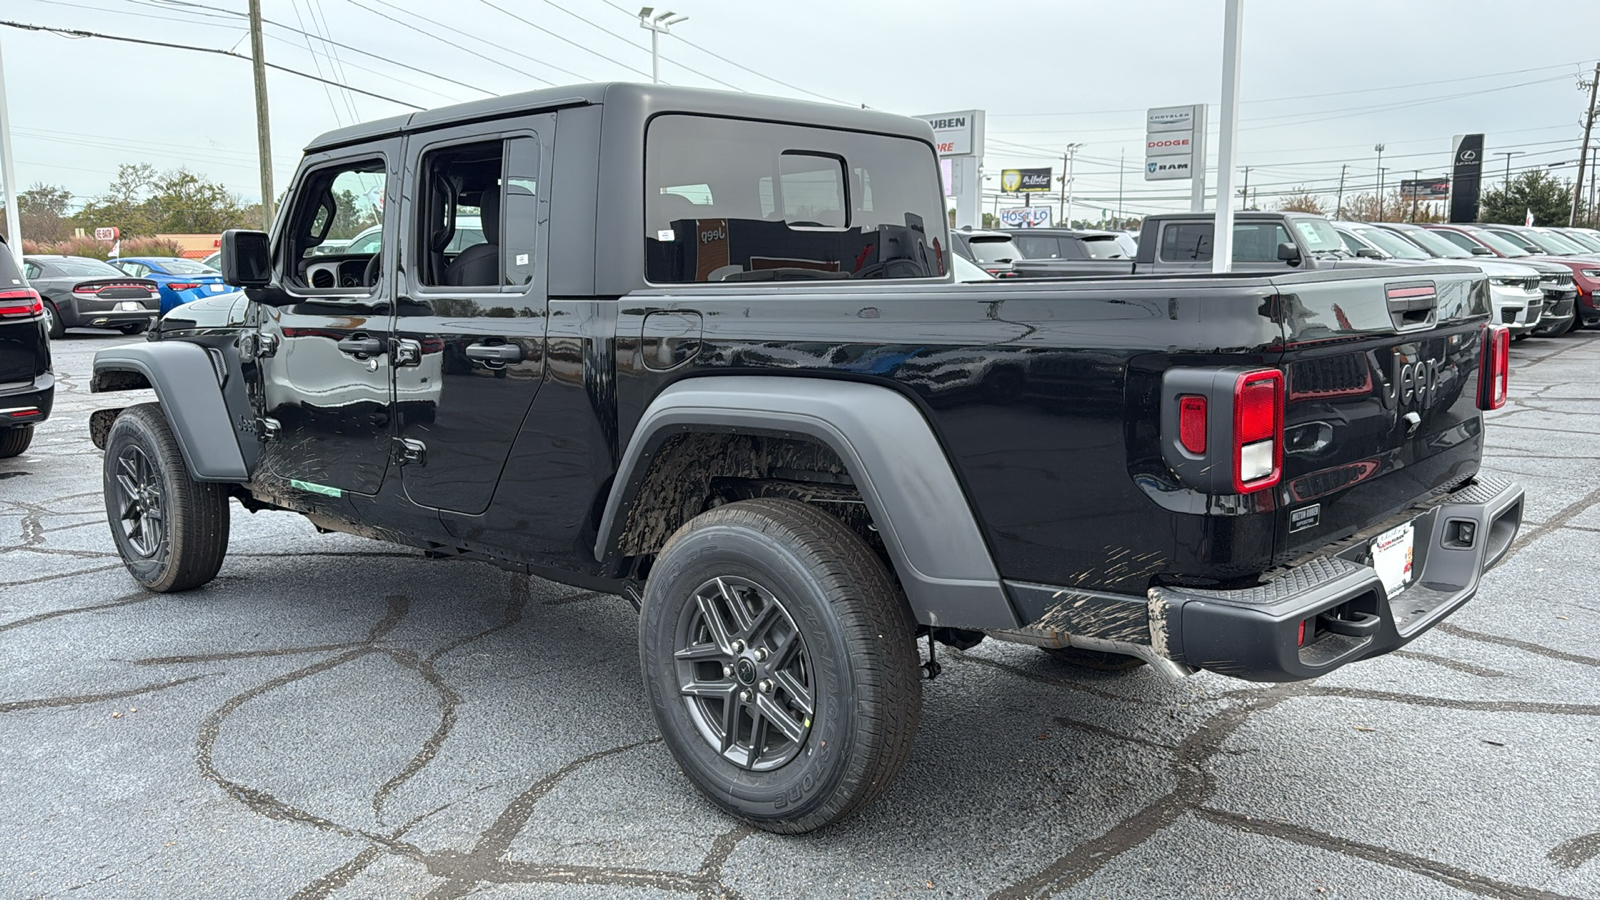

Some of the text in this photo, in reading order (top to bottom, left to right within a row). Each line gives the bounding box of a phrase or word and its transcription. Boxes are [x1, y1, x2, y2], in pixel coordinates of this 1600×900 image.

[930, 117, 965, 130] UBEN
[1148, 139, 1190, 148] DODGE
[1159, 163, 1188, 171] RAM
[1001, 210, 1048, 222] HOSTLO
[1382, 352, 1438, 410] Jeep
